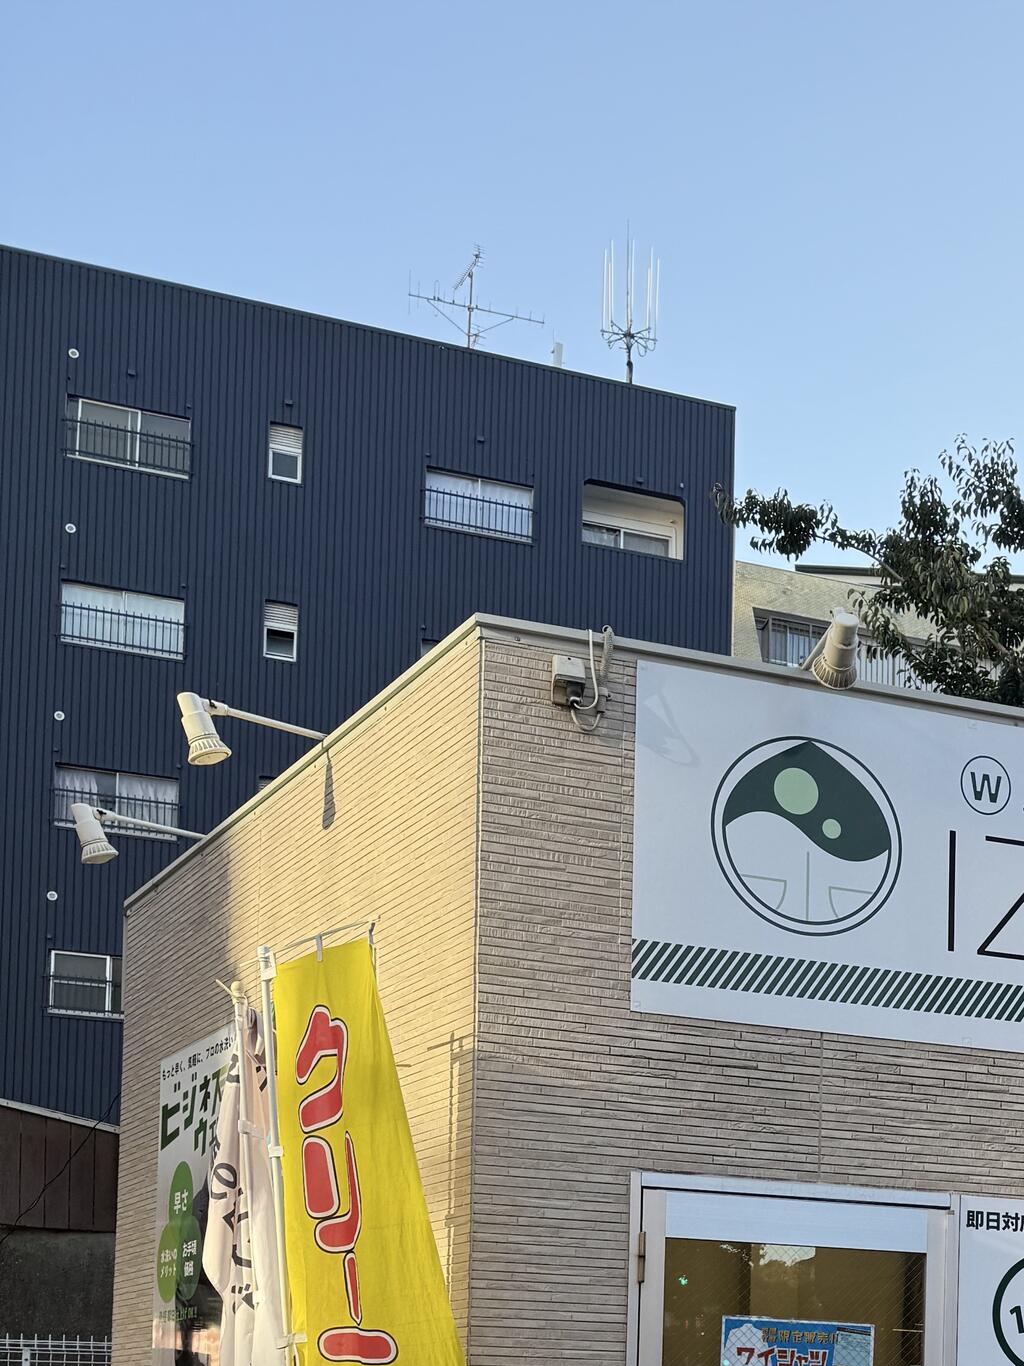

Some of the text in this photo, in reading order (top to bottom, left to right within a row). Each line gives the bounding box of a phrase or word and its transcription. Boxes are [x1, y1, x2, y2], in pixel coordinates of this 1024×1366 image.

[173, 1189, 188, 1215] 早さ
[160, 1263, 178, 1278] メリット
